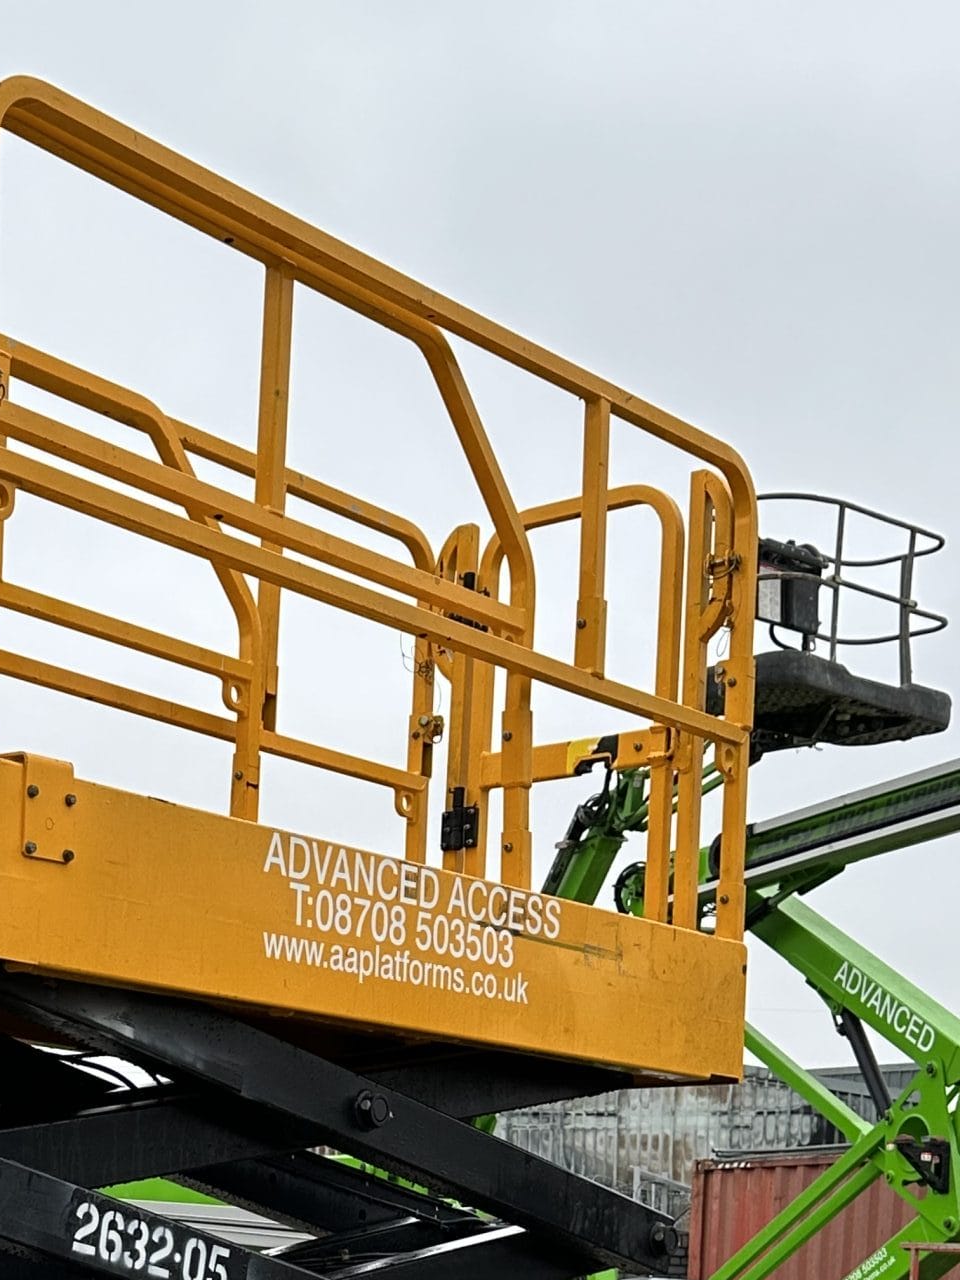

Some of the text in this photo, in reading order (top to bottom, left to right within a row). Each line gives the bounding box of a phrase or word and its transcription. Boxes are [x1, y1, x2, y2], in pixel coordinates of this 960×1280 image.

[263, 832, 561, 939] ADVANCED ACCESS
[290, 882, 514, 968] T:08708 503503
[263, 932, 529, 1004] www.aaplatforms.co.uk
[833, 961, 935, 1052] ADVANCED
